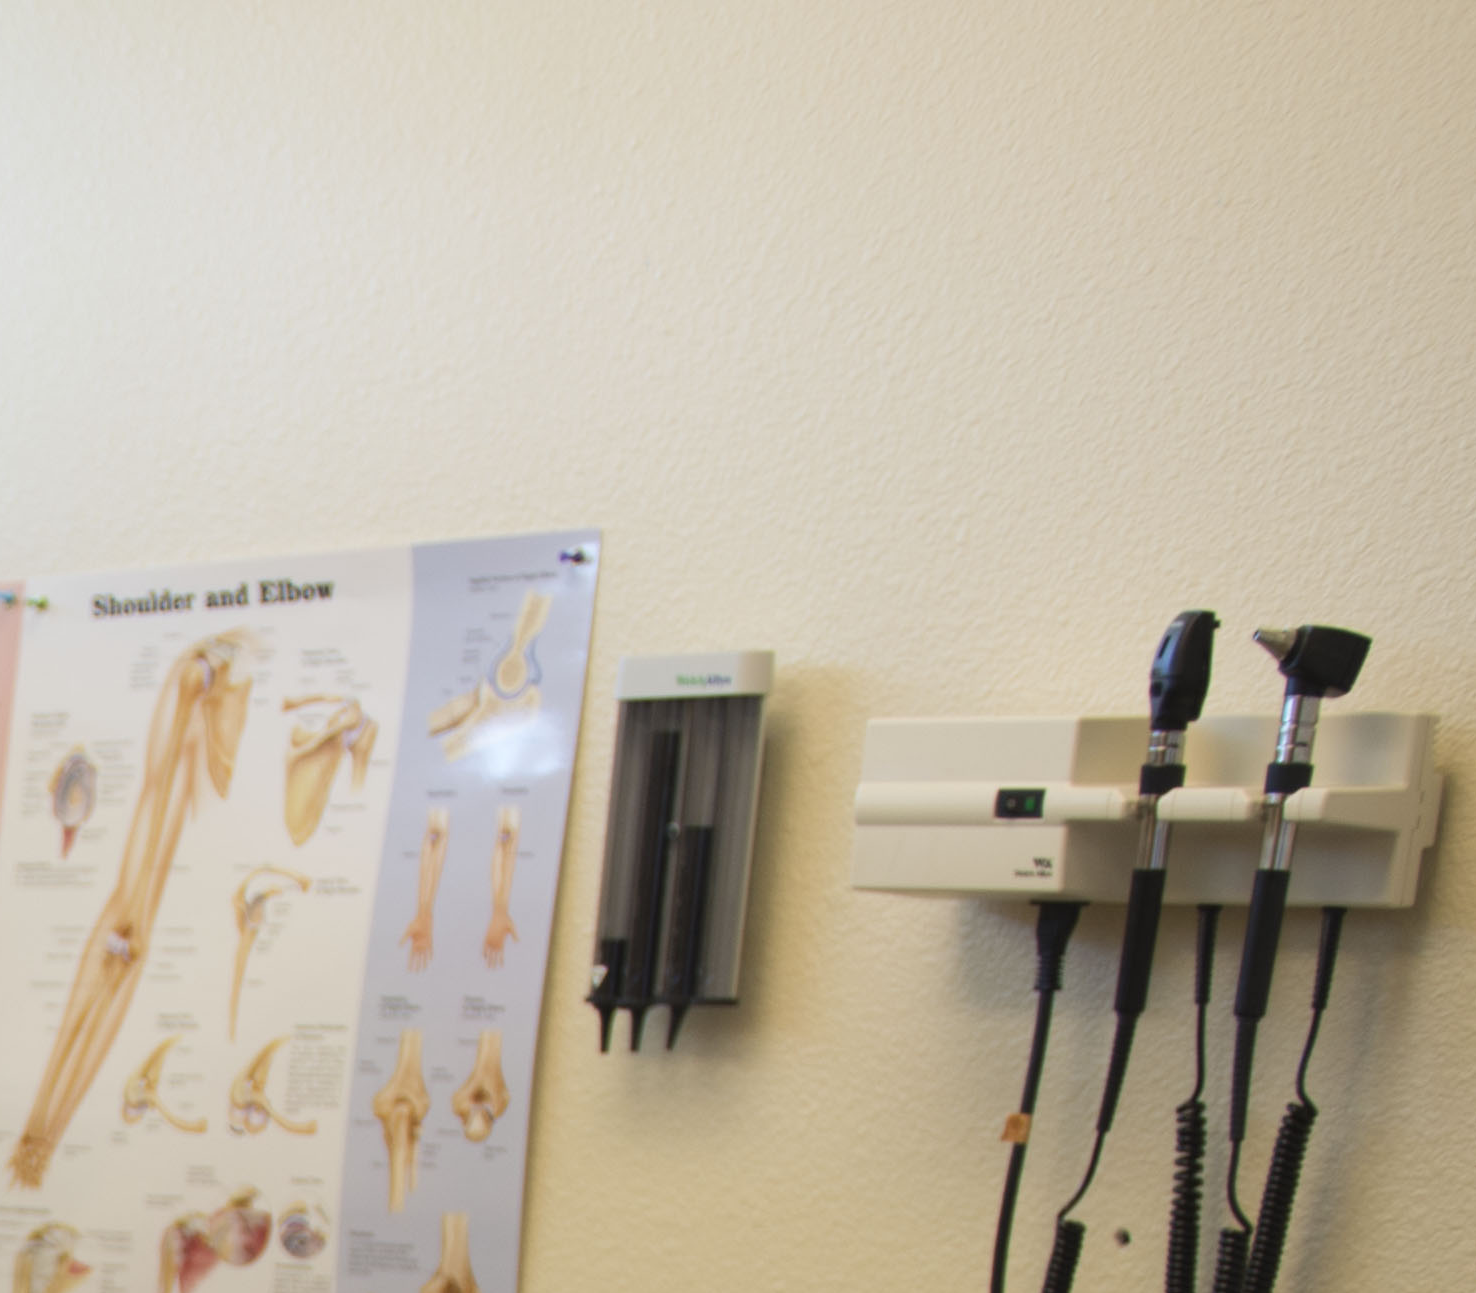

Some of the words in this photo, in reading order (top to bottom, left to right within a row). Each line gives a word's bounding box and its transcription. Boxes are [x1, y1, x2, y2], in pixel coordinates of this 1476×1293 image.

[91, 589, 195, 619] Shoulder
[206, 584, 250, 609] and
[259, 577, 335, 604] Elbow
